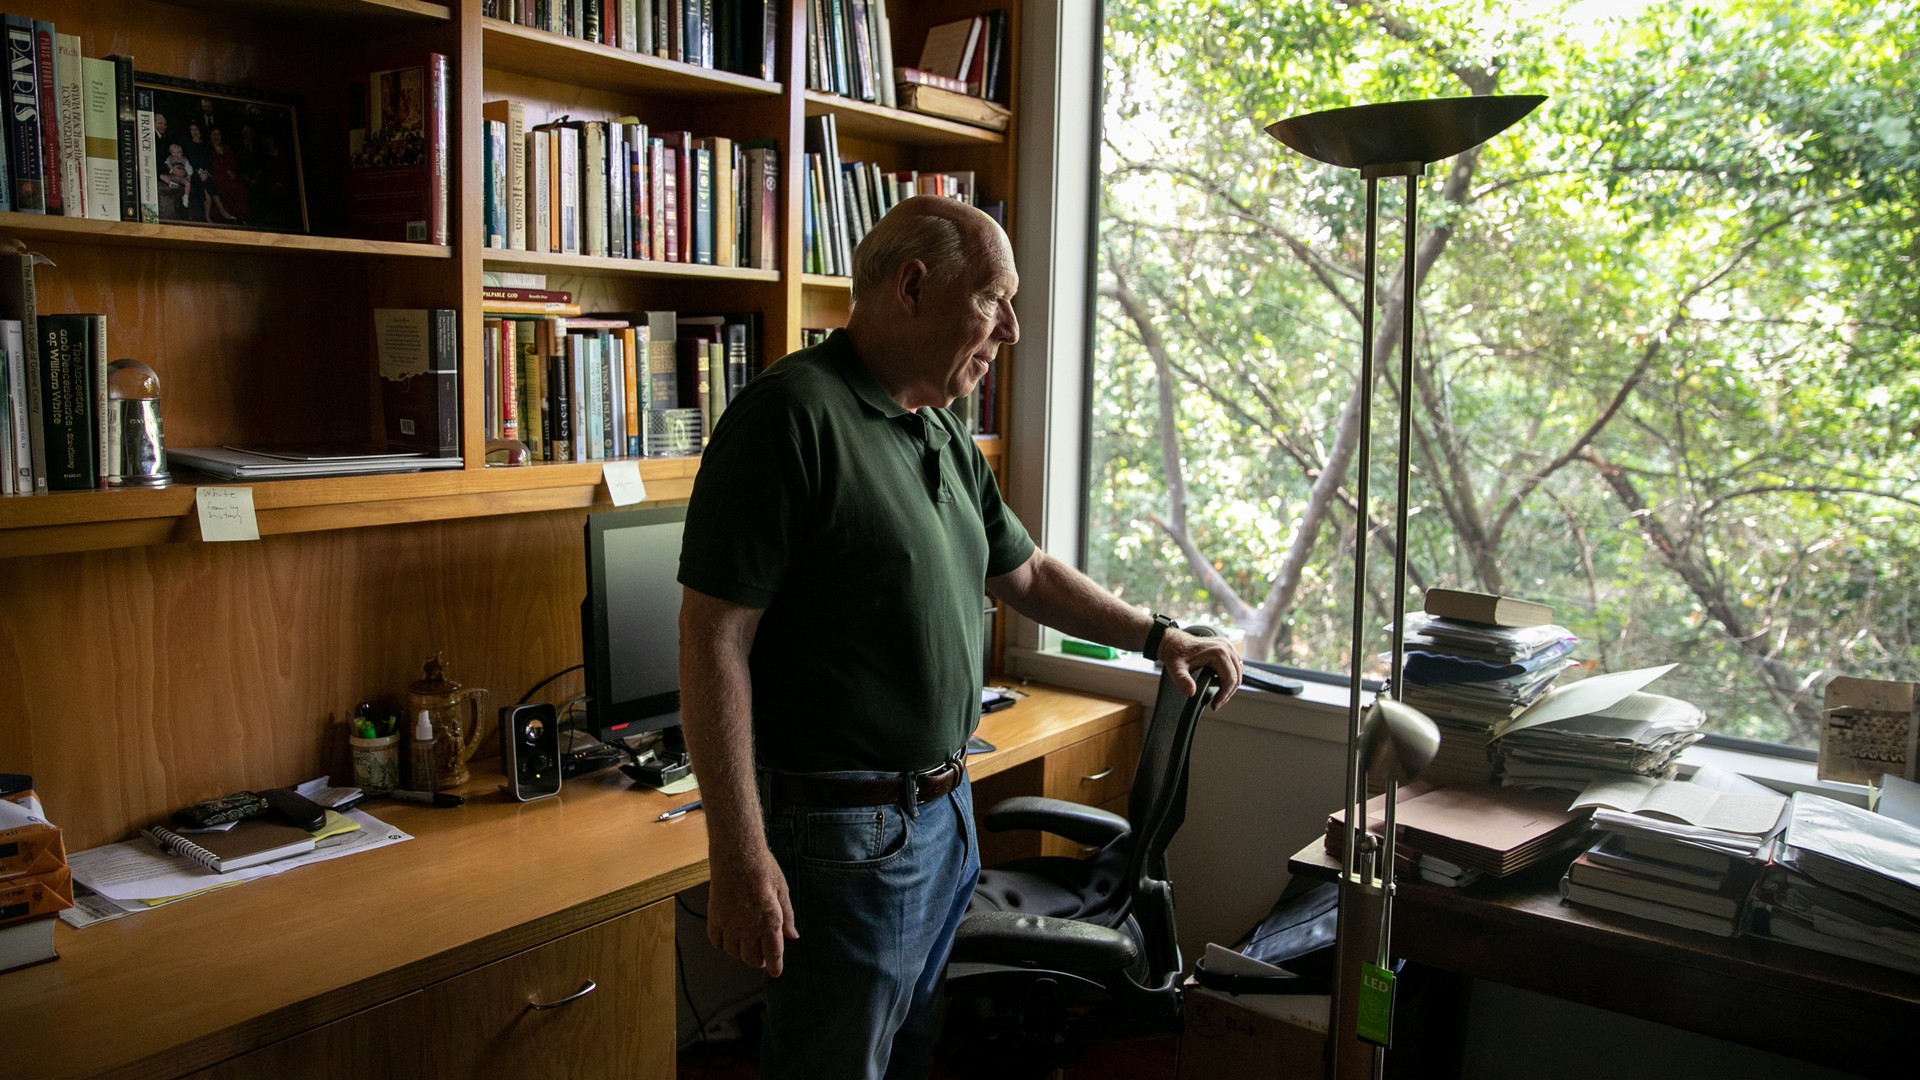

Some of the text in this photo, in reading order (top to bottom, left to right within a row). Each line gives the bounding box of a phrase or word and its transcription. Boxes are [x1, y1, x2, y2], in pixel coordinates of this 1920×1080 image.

[40, 37, 52, 58] PARIS
[58, 46, 79, 57] Fitch
[8, 29, 37, 121] PARIS
[71, 83, 80, 110] SYLVIA
[61, 86, 73, 160] LOST GENERATION
[72, 111, 82, 138] BEACH
[141, 114, 151, 152] FRANCE
[73, 138, 82, 152] and
[124, 129, 134, 197] EIFFEL'S TOWER
[512, 142, 523, 174] BIBLE
[516, 174, 523, 185] AS
[512, 187, 523, 233] HISTORY
[482, 291, 505, 299] PALPABLE
[26, 305, 34, 326] Creek
[27, 327, 36, 351] Ledger
[60, 329, 69, 351] and
[30, 362, 38, 387] Greene
[47, 332, 62, 425] of William White
[72, 342, 85, 416] The Ancestry
[640, 364, 649, 385] Dead
[31, 389, 40, 414] County
[61, 354, 73, 426] Descendants
[596, 394, 601, 402] OF
[559, 396, 568, 437] JESUS
[603, 400, 611, 431] ISLAM
[203, 488, 240, 498] White
[206, 501, 239, 516] family
[208, 511, 243, 524] history
[1363, 974, 1389, 993] LED
